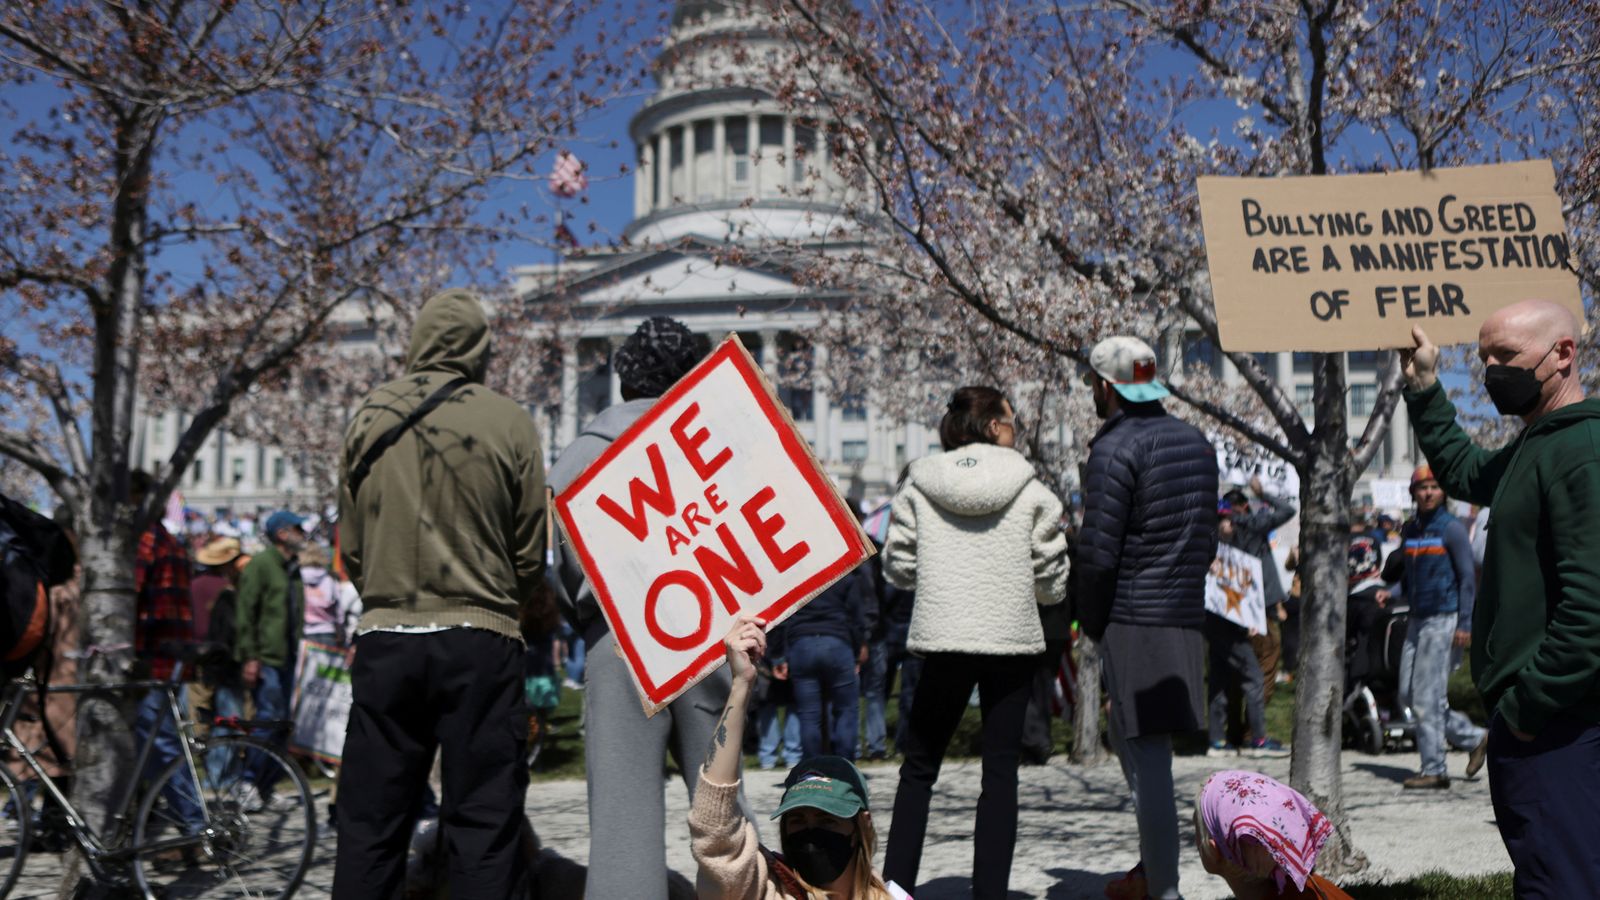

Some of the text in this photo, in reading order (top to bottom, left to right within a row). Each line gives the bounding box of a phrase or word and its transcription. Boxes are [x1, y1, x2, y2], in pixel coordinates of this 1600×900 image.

[1243, 195, 1536, 237] BULLYING AND GREED
[1252, 233, 1571, 273] ARE A MANIFESTATION
[1311, 284, 1471, 320] OF FEAR
[596, 402, 734, 541] WE
[665, 484, 728, 555] ARE
[644, 486, 810, 651] ONE
